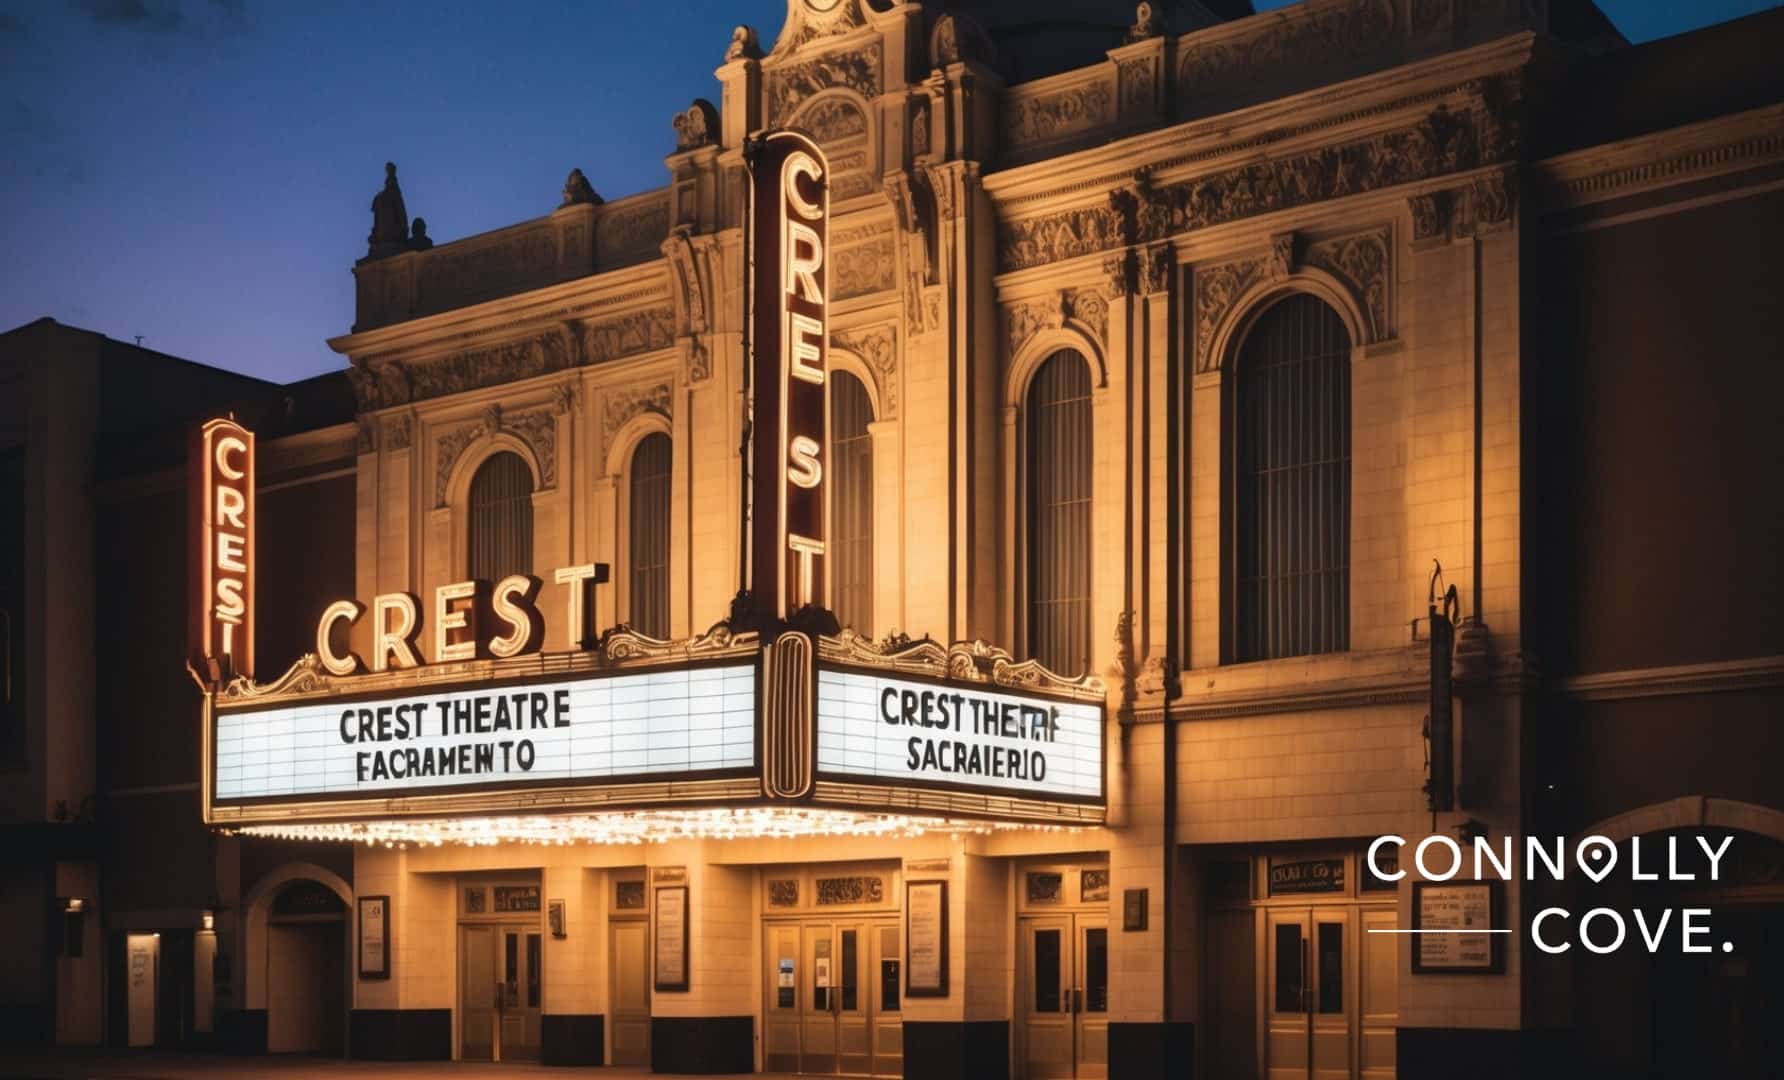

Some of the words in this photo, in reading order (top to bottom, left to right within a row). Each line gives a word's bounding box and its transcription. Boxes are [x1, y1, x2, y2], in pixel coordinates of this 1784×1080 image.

[785, 150, 825, 608] CREST
[215, 436, 246, 655] CREST
[317, 564, 605, 676] CREST
[340, 703, 429, 744] CREST
[436, 690, 570, 736] THEATRE
[881, 687, 964, 731] CREST
